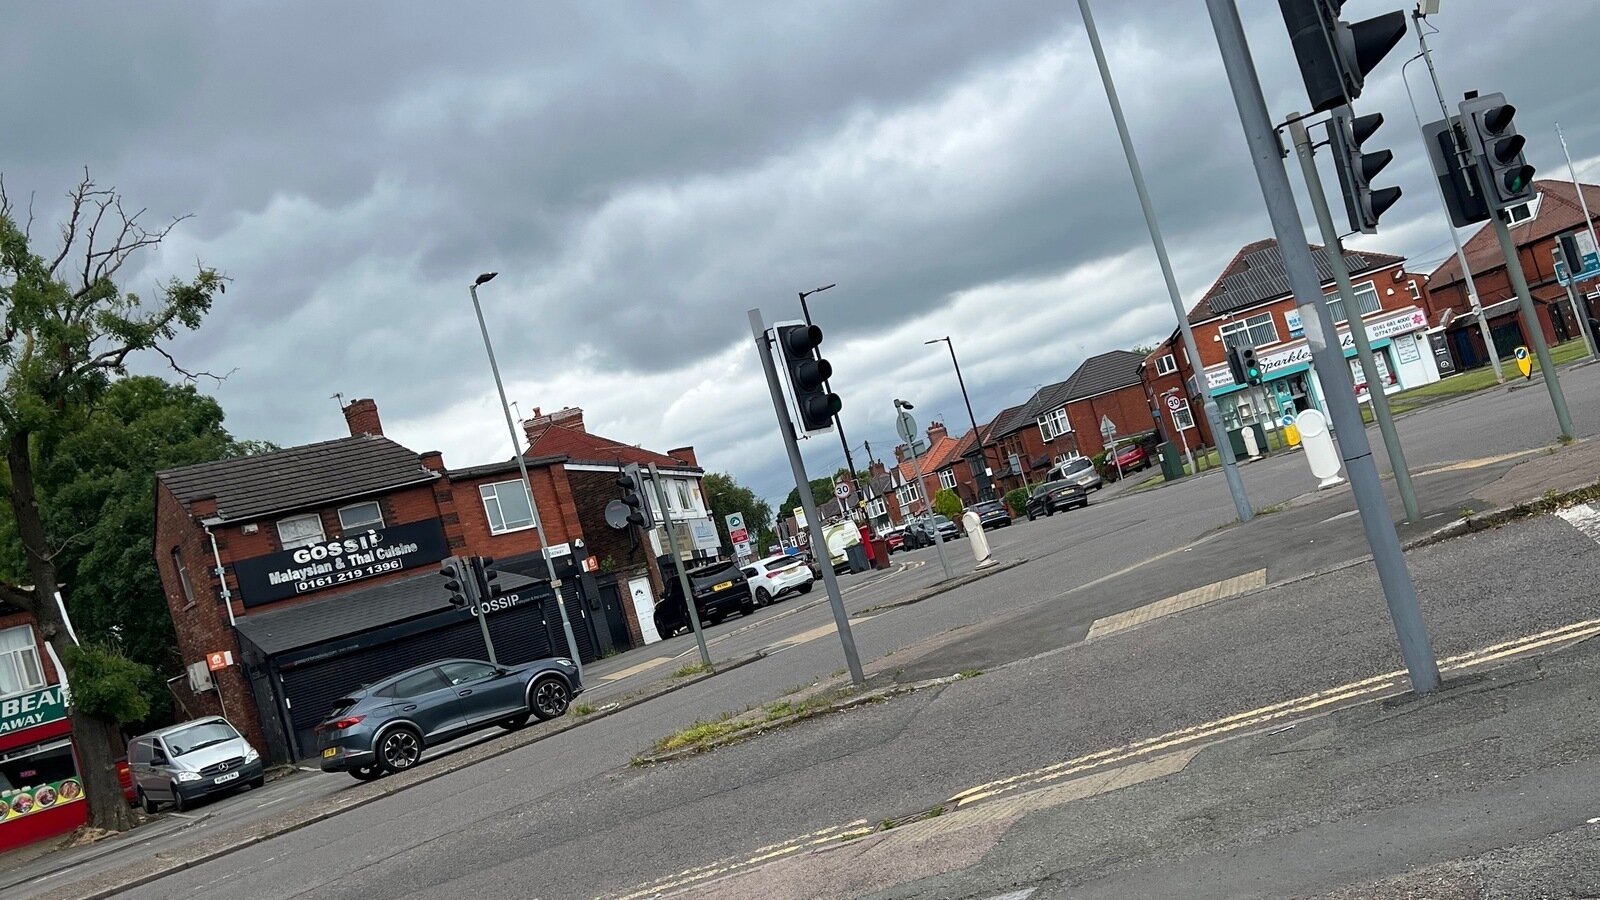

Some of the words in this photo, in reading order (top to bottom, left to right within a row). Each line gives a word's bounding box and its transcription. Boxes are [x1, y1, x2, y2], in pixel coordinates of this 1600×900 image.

[1373, 323, 1386, 332] 0161
[1386, 320, 1396, 328] 681
[1397, 316, 1410, 324] 4000
[1260, 349, 1313, 373] Sparkles
[1168, 398, 1179, 407] 30
[836, 485, 849, 495] 30
[293, 532, 384, 564] GOSSIP
[268, 562, 333, 585] Malaysian
[335, 557, 346, 570] &
[347, 550, 375, 567] Thai
[376, 543, 418, 560] Cuisine
[298, 576, 333, 591] 0161
[337, 569, 363, 582] 219
[366, 560, 399, 576] 1396
[470, 594, 520, 617] GOSSIP
[0, 711, 45, 733] AWAY
